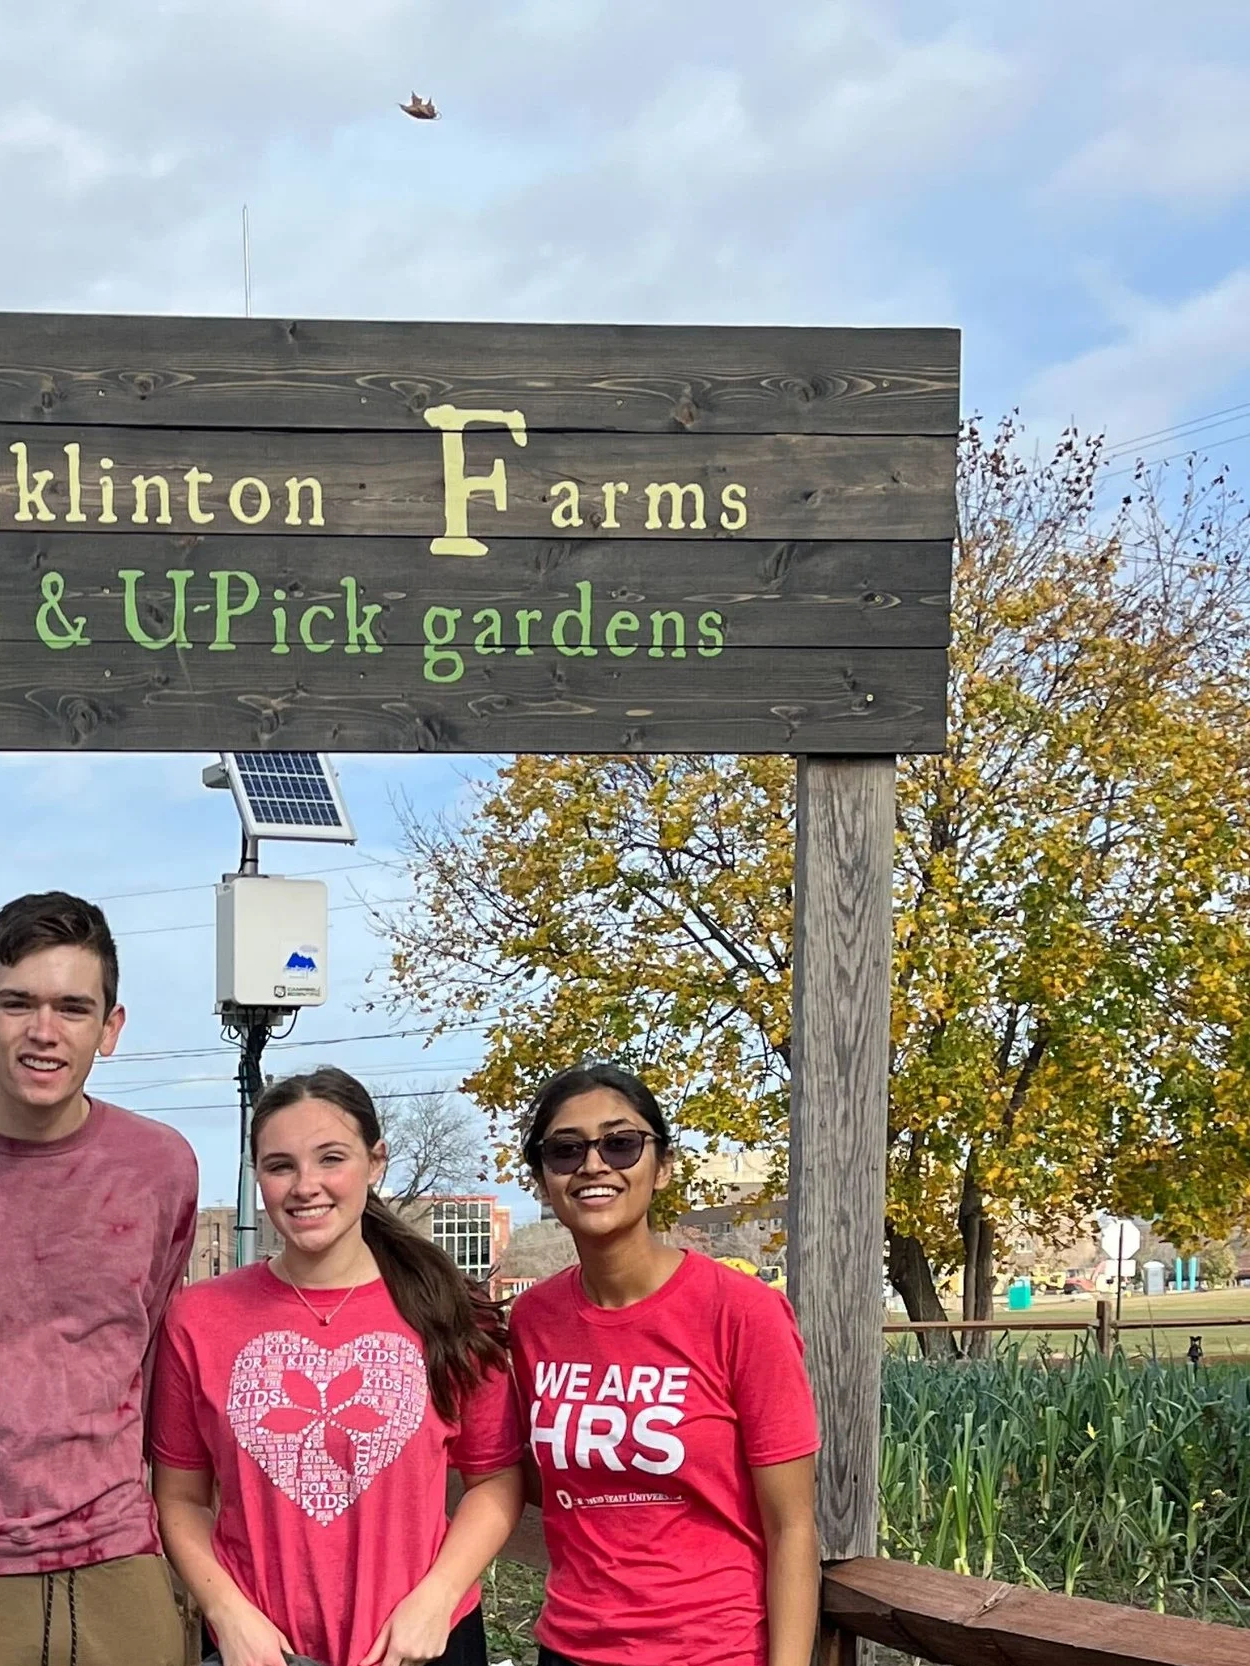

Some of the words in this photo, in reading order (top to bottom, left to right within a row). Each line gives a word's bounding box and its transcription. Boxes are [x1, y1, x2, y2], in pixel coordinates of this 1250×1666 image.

[425, 406, 746, 555] Farms
[36, 573, 87, 648] &
[423, 582, 722, 682] gardens
[264, 1343, 301, 1355] KIDS
[354, 1338, 380, 1348] FOR
[235, 1357, 261, 1371] FOR
[287, 1355, 327, 1367] KIDS
[353, 1349, 399, 1364] KIDS
[233, 1380, 259, 1393] FOR
[362, 1378, 402, 1392] KIDS
[535, 1361, 592, 1400] WE
[595, 1364, 691, 1403] ARE
[232, 1390, 281, 1409] KIDS
[353, 1395, 379, 1407] FOR
[371, 1433, 382, 1457] FOR
[530, 1400, 686, 1475] HRS
[355, 1432, 371, 1475] KIDS
[301, 1482, 329, 1493] FOR
[301, 1494, 349, 1509] KIDS
